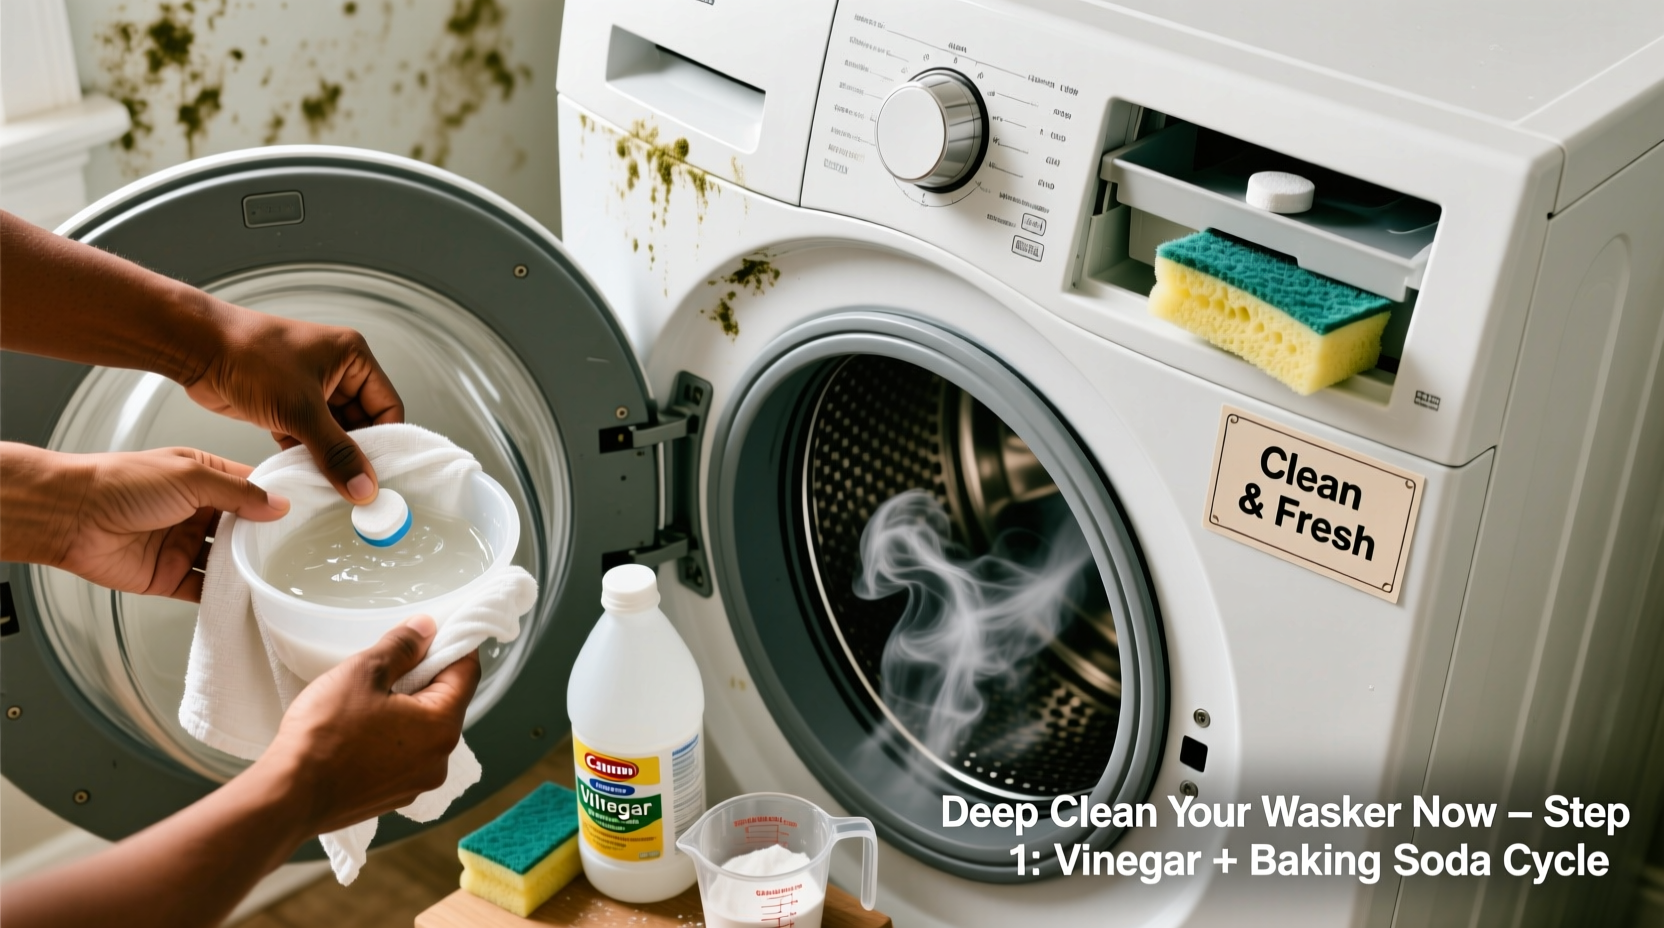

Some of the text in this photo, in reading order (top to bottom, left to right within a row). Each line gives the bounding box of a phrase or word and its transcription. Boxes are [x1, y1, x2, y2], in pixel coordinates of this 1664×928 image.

[1260, 445, 1363, 511] Clean
[1238, 482, 1376, 562] & Fresh
